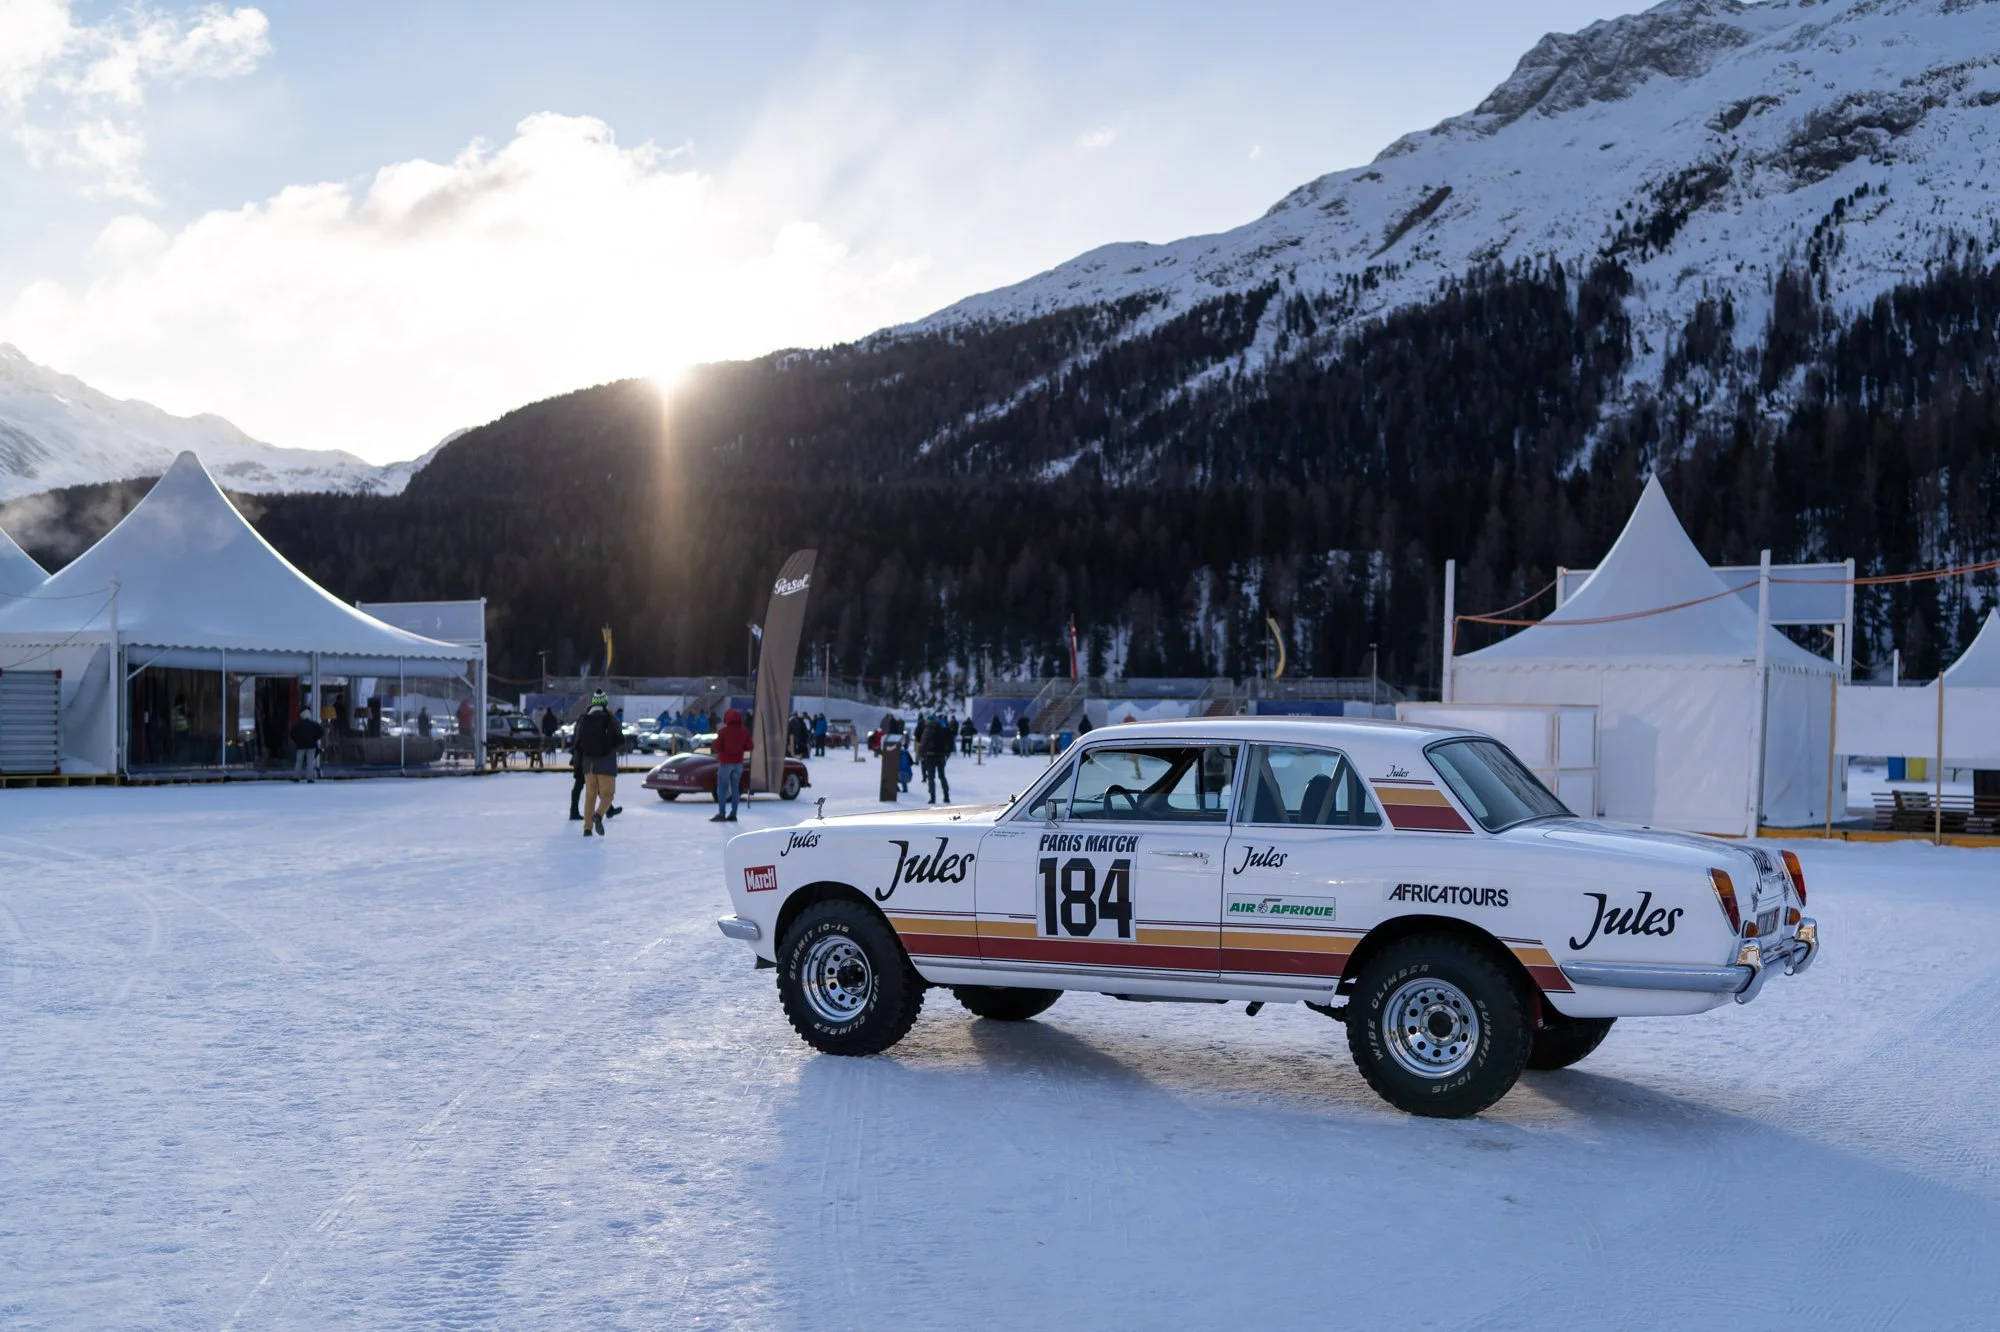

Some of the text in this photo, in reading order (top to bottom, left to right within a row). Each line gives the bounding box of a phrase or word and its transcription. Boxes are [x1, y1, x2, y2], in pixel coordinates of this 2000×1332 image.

[774, 573, 809, 596] Persol
[1386, 765, 1409, 777] Jules
[780, 830, 821, 857] Jules
[1039, 834, 1139, 853] PARIS MATCH
[875, 836, 975, 902] Jules
[1232, 845, 1288, 875] Jules
[1038, 857, 1133, 938] 184
[1229, 902, 1333, 916] AIR AFRIQUE
[1388, 883, 1509, 907] AFRICATOURS
[1568, 890, 1684, 951] Jules
[789, 930, 814, 981] SUMMIT
[814, 1015, 866, 1036] CLIMBER
[1367, 964, 1430, 1061] WIDE CLIMBER
[1476, 999, 1492, 1068] SUMMIT
